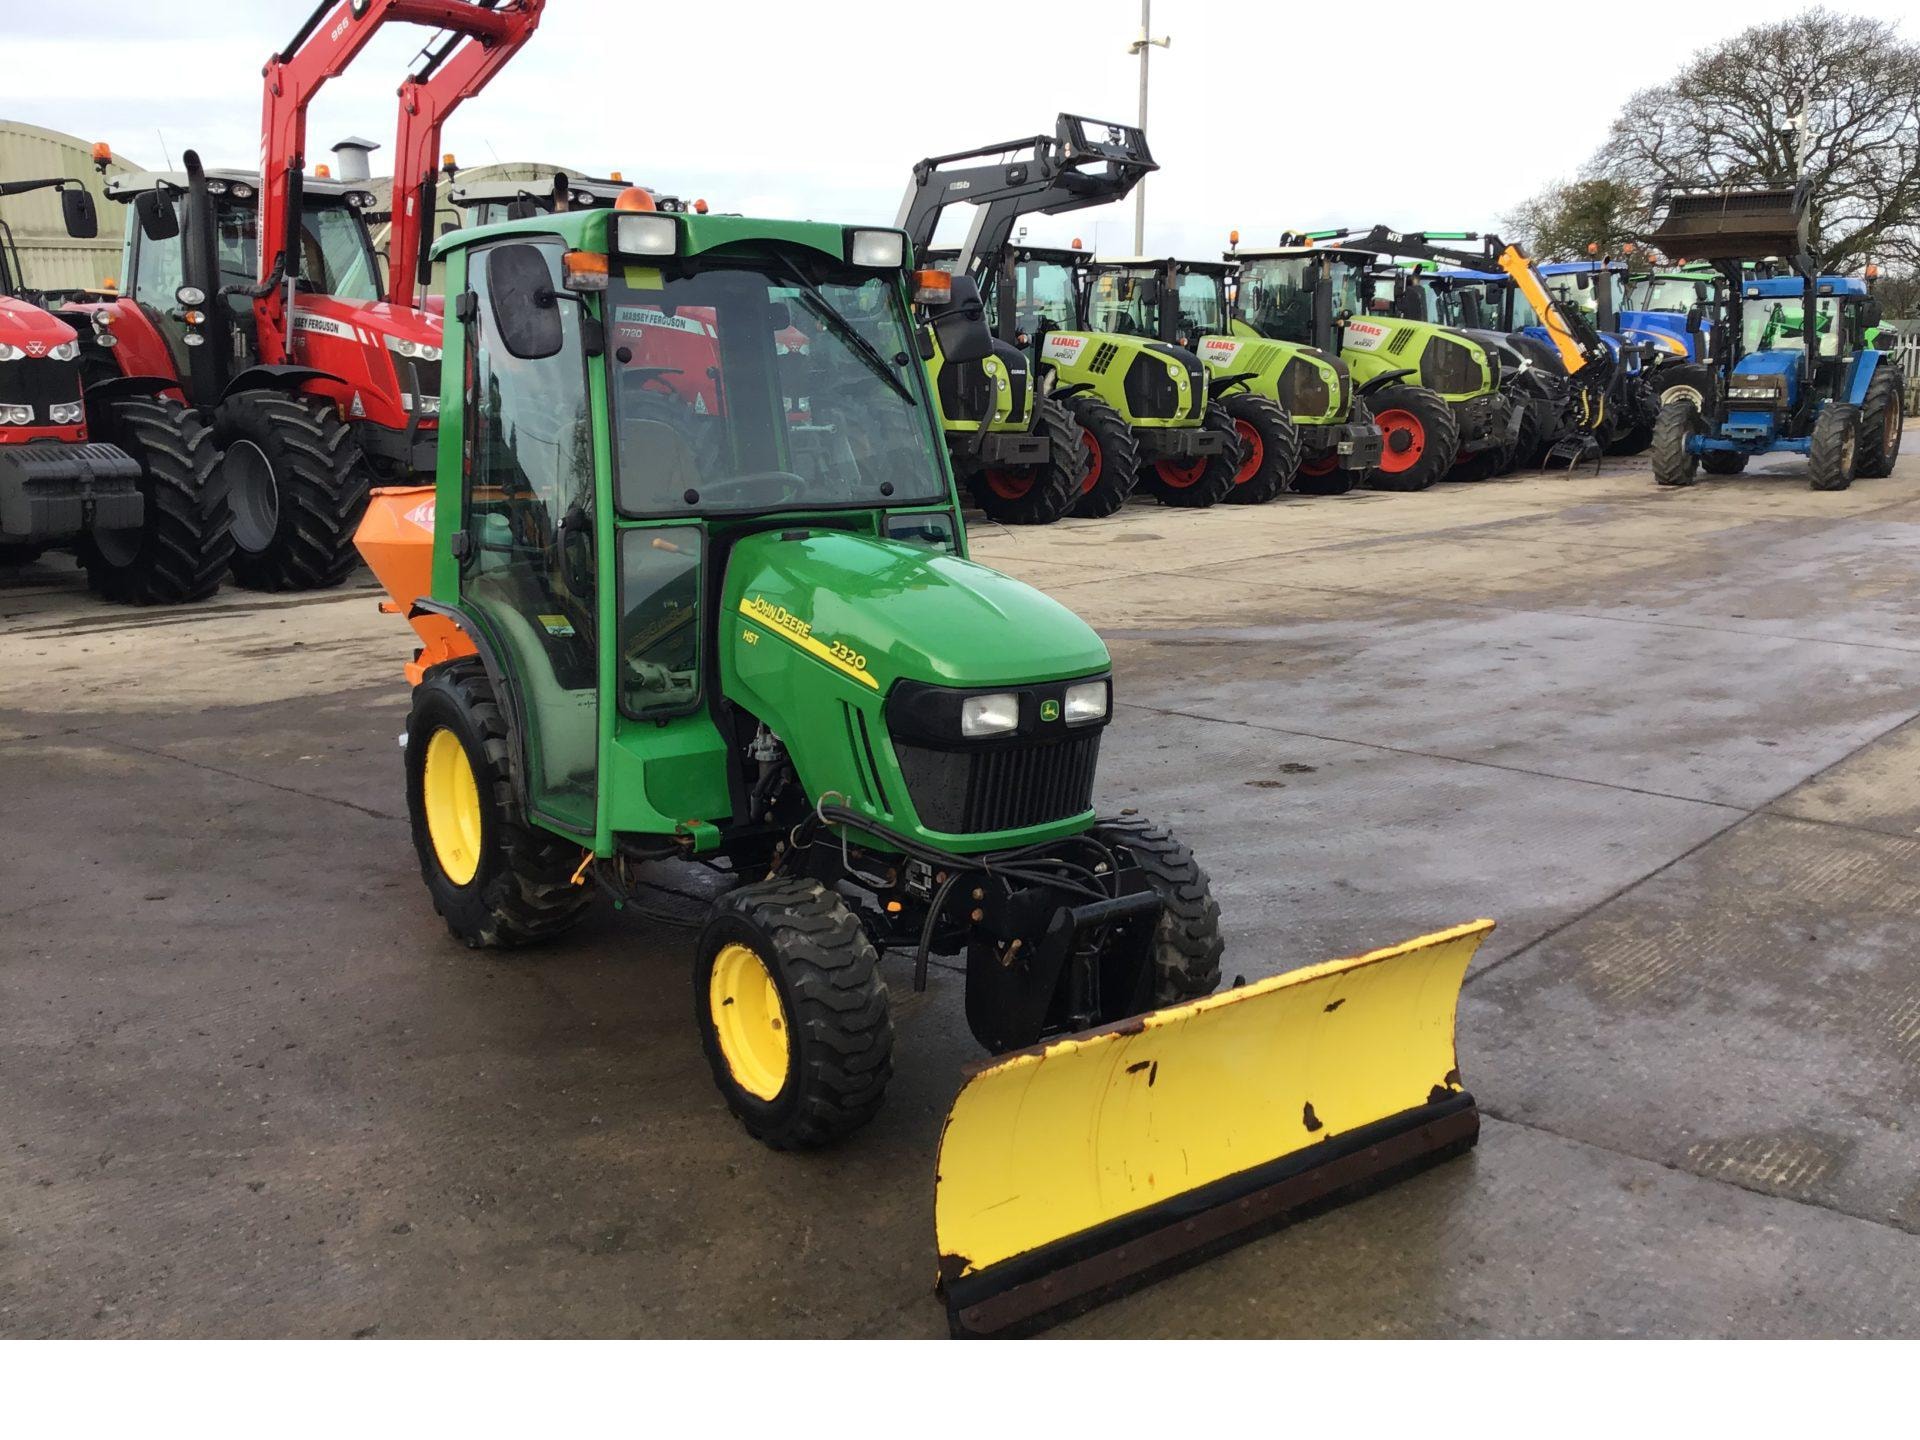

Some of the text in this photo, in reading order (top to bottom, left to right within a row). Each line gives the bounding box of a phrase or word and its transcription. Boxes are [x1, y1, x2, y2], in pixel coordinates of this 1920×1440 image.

[331, 16, 349, 42] 966
[308, 318, 339, 334] FERGUSON
[622, 311, 686, 329] MASSEY FERGUSON
[620, 328, 642, 338] 7720
[1350, 323, 1382, 337] CLAAS
[1052, 337, 1081, 348] CLAAS
[1206, 341, 1236, 351] CLAAS
[1054, 352, 1072, 360] ARION
[1208, 355, 1228, 363] ARION
[775, 606, 812, 639] DEERE
[742, 629, 760, 646] HST
[830, 640, 867, 670] 2320
